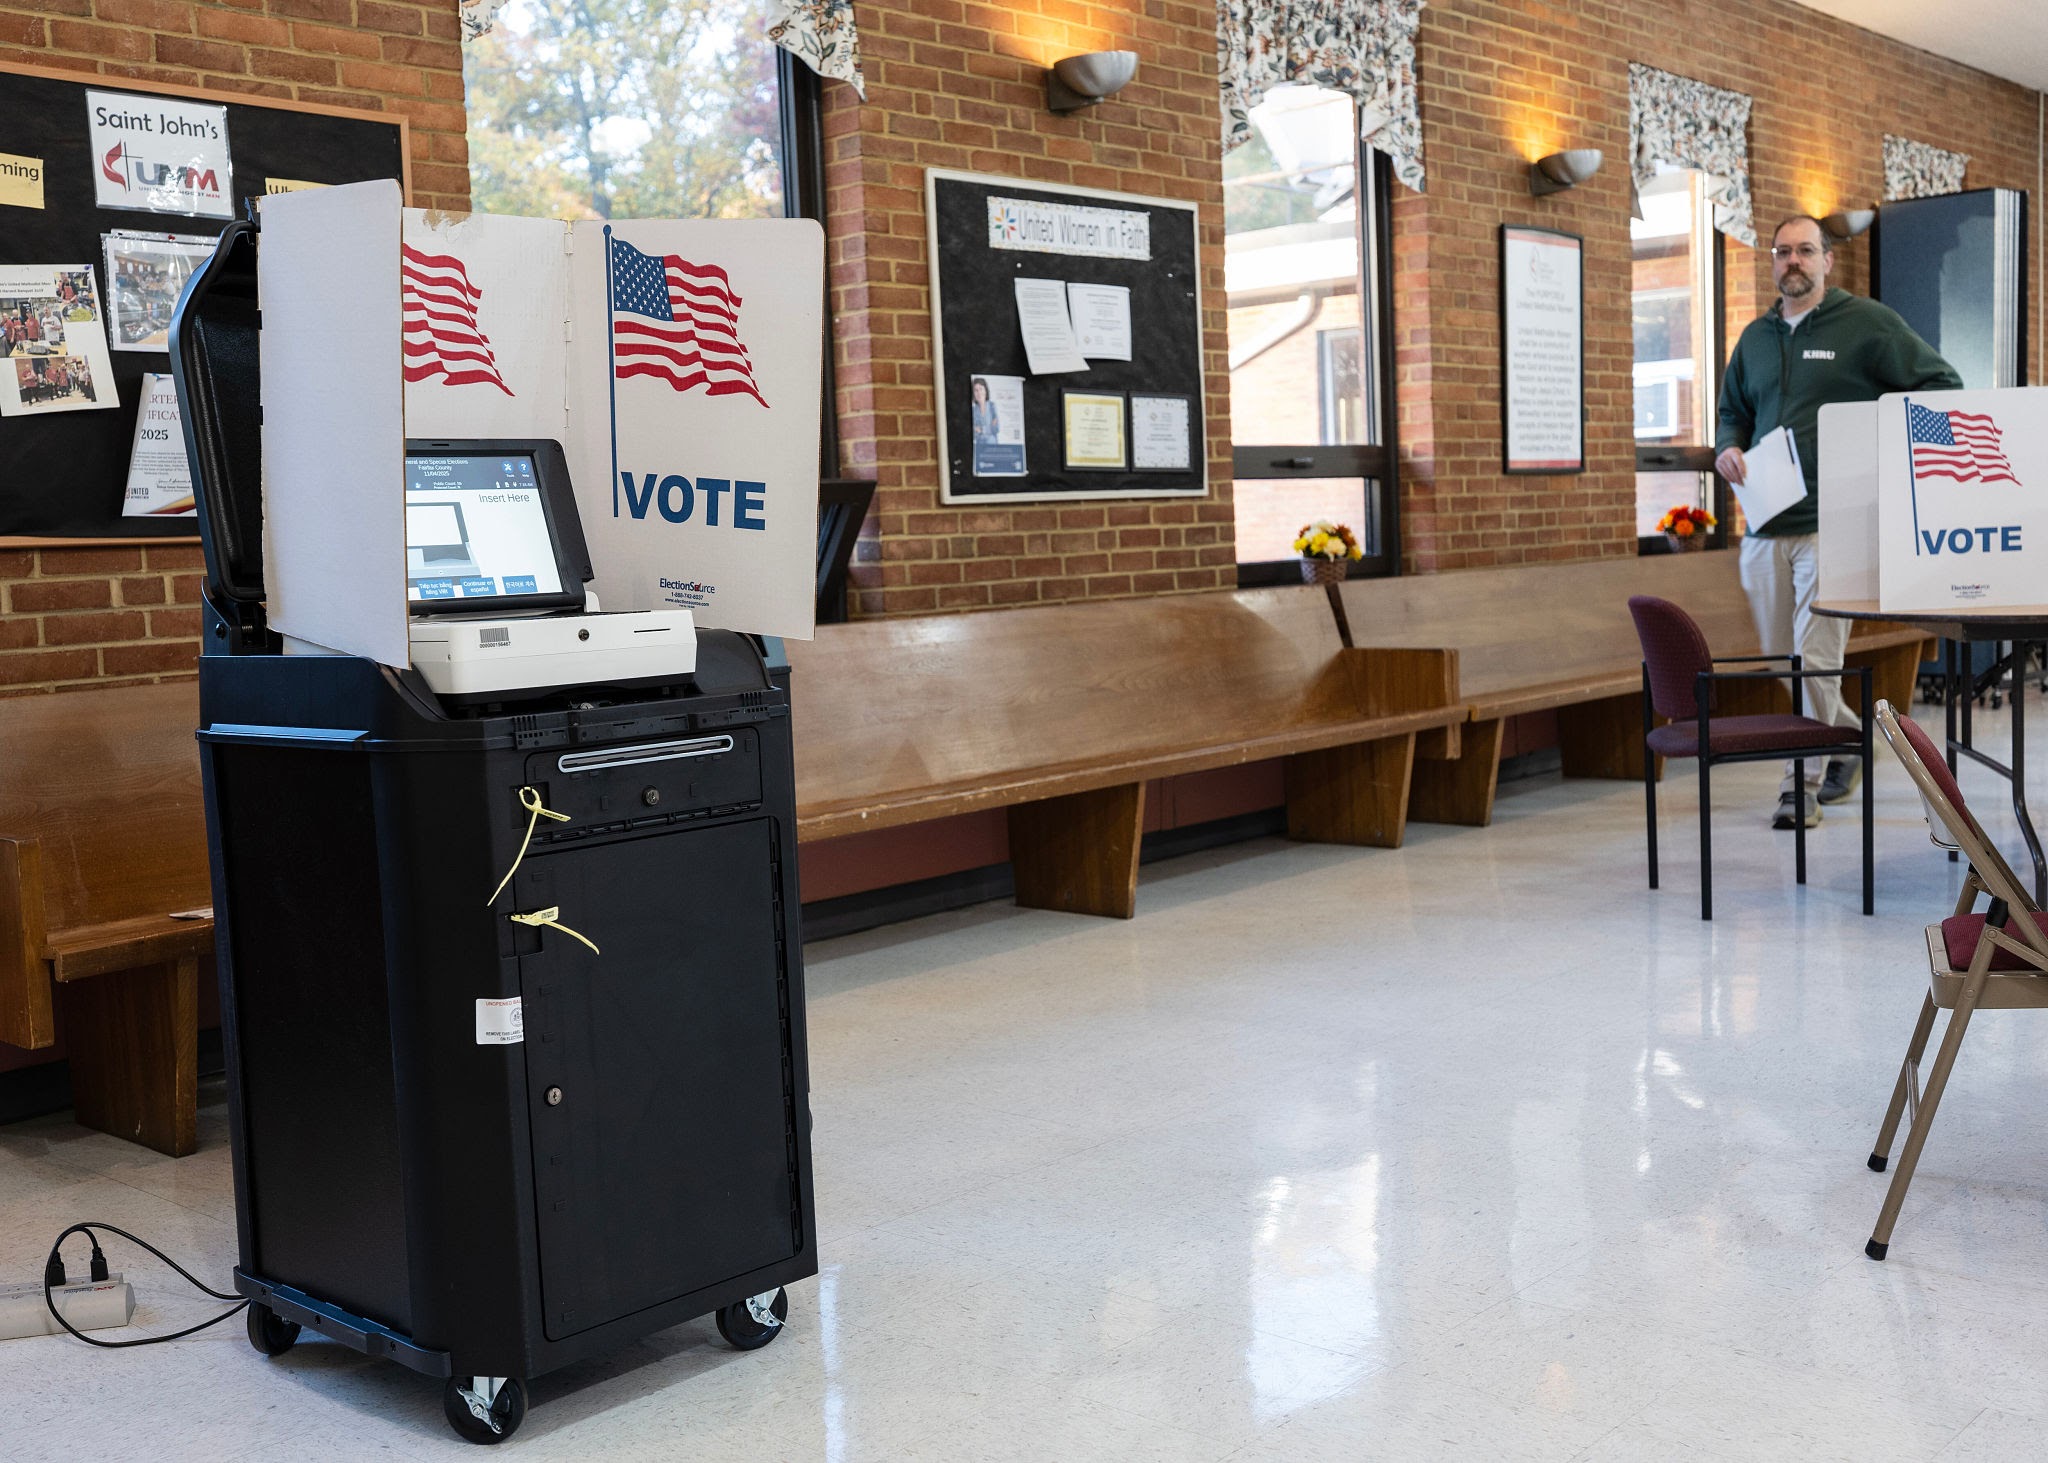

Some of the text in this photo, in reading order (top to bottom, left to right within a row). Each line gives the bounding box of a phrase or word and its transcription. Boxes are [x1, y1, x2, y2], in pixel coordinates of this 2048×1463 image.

[96, 106, 218, 140] Saint John's
[1018, 209, 1147, 249] United Women in Faith
[141, 428, 169, 441] 2025
[479, 493, 530, 503] Insert Here
[621, 471, 766, 530] VOTE
[1921, 526, 2022, 555] VOTE
